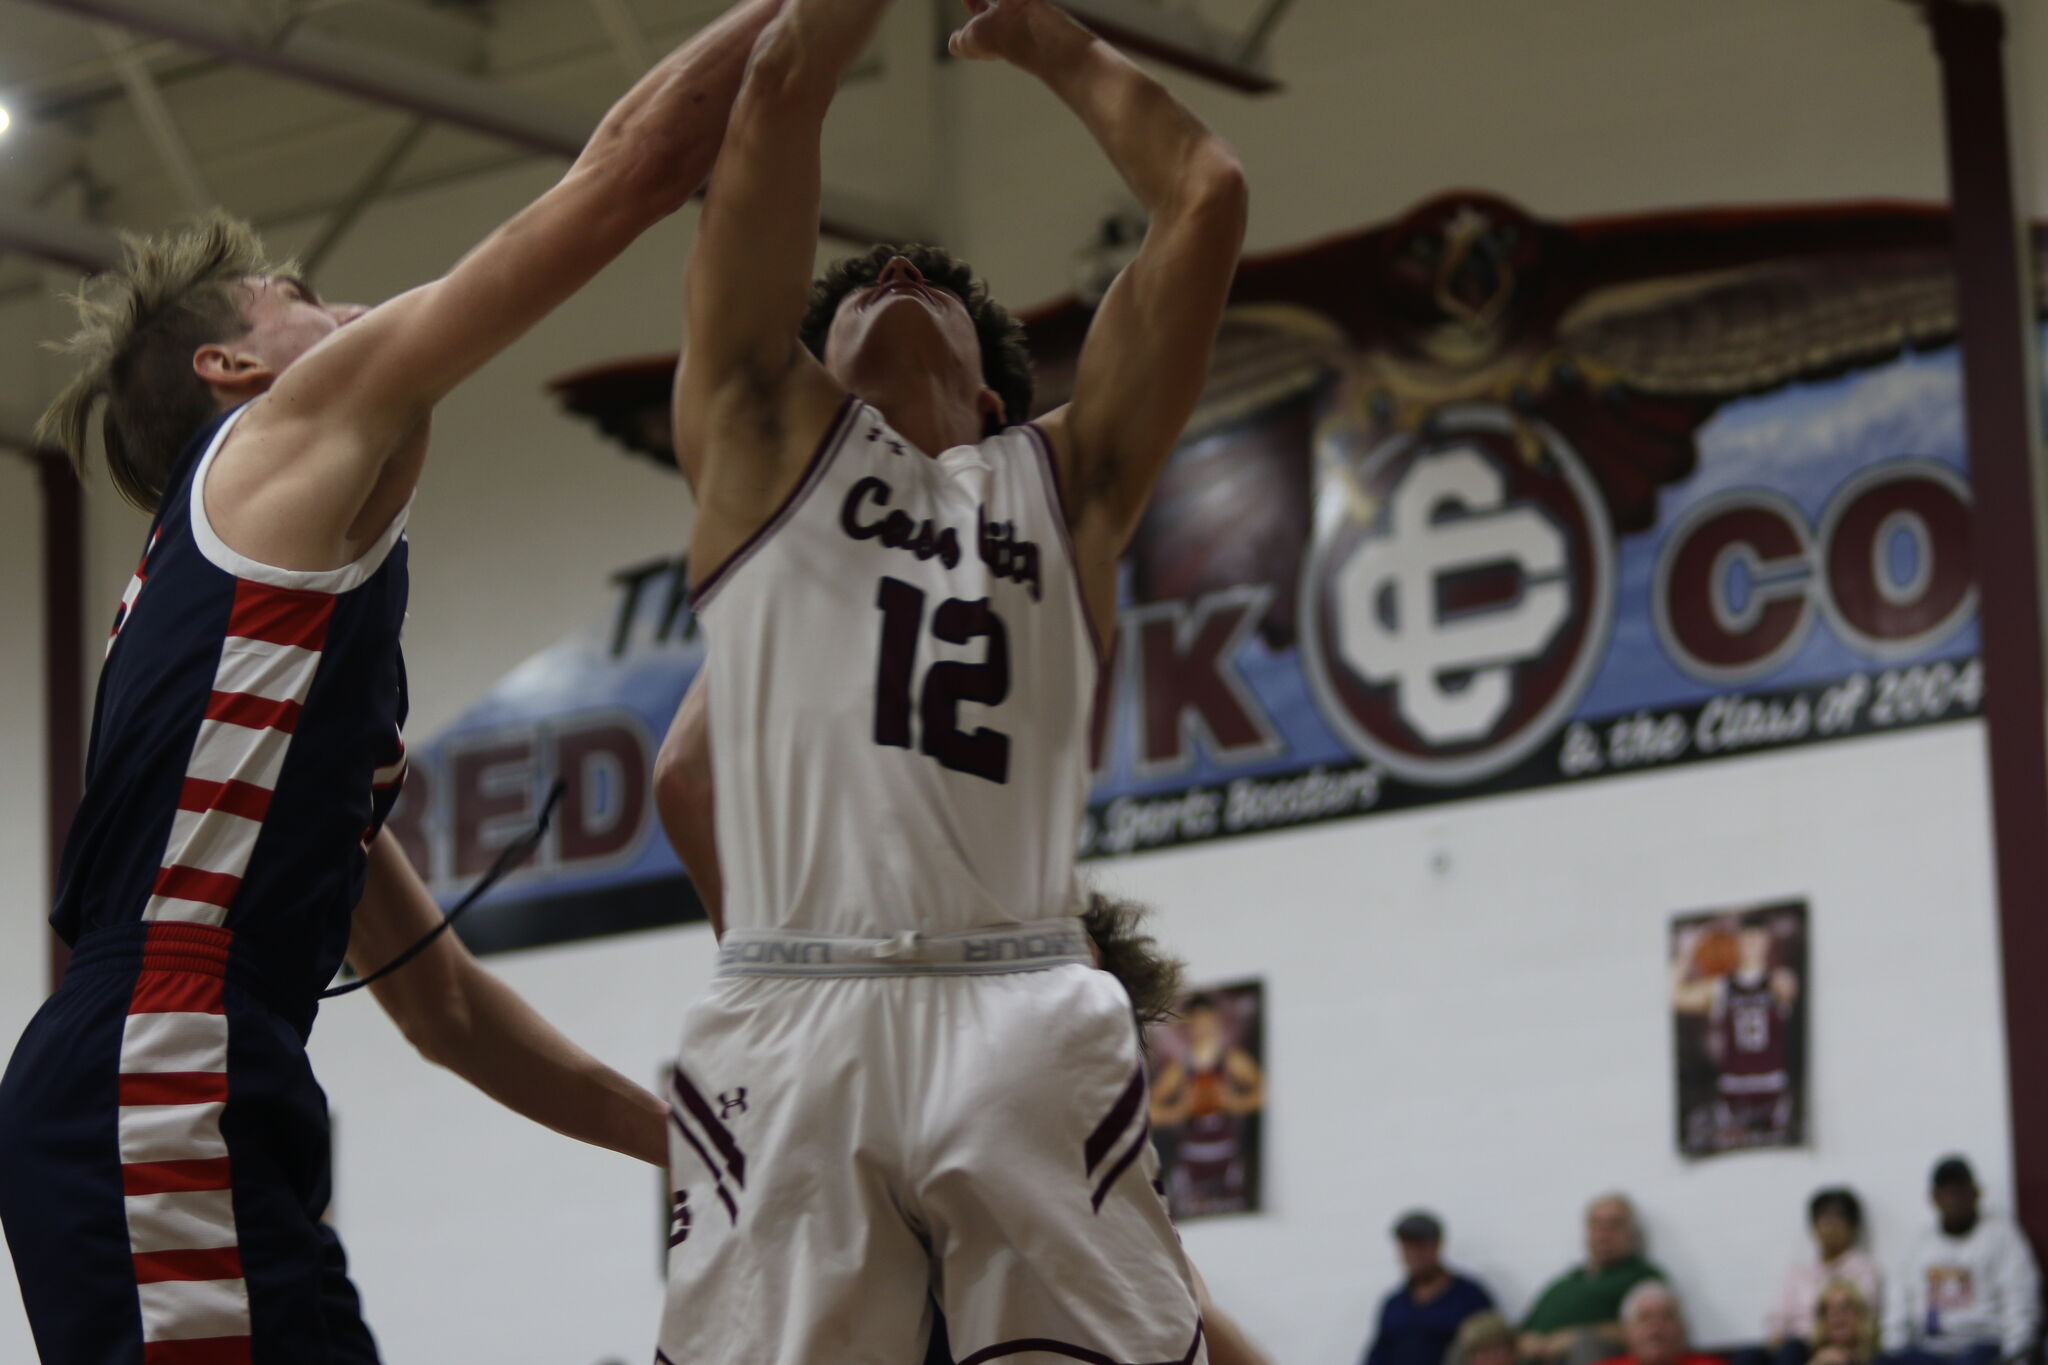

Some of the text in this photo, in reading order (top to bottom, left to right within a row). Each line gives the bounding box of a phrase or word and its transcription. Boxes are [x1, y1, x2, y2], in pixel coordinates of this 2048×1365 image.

[873, 574, 1011, 786] 12
[1694, 695, 1811, 753] Class
[1870, 658, 1984, 725] 2004
